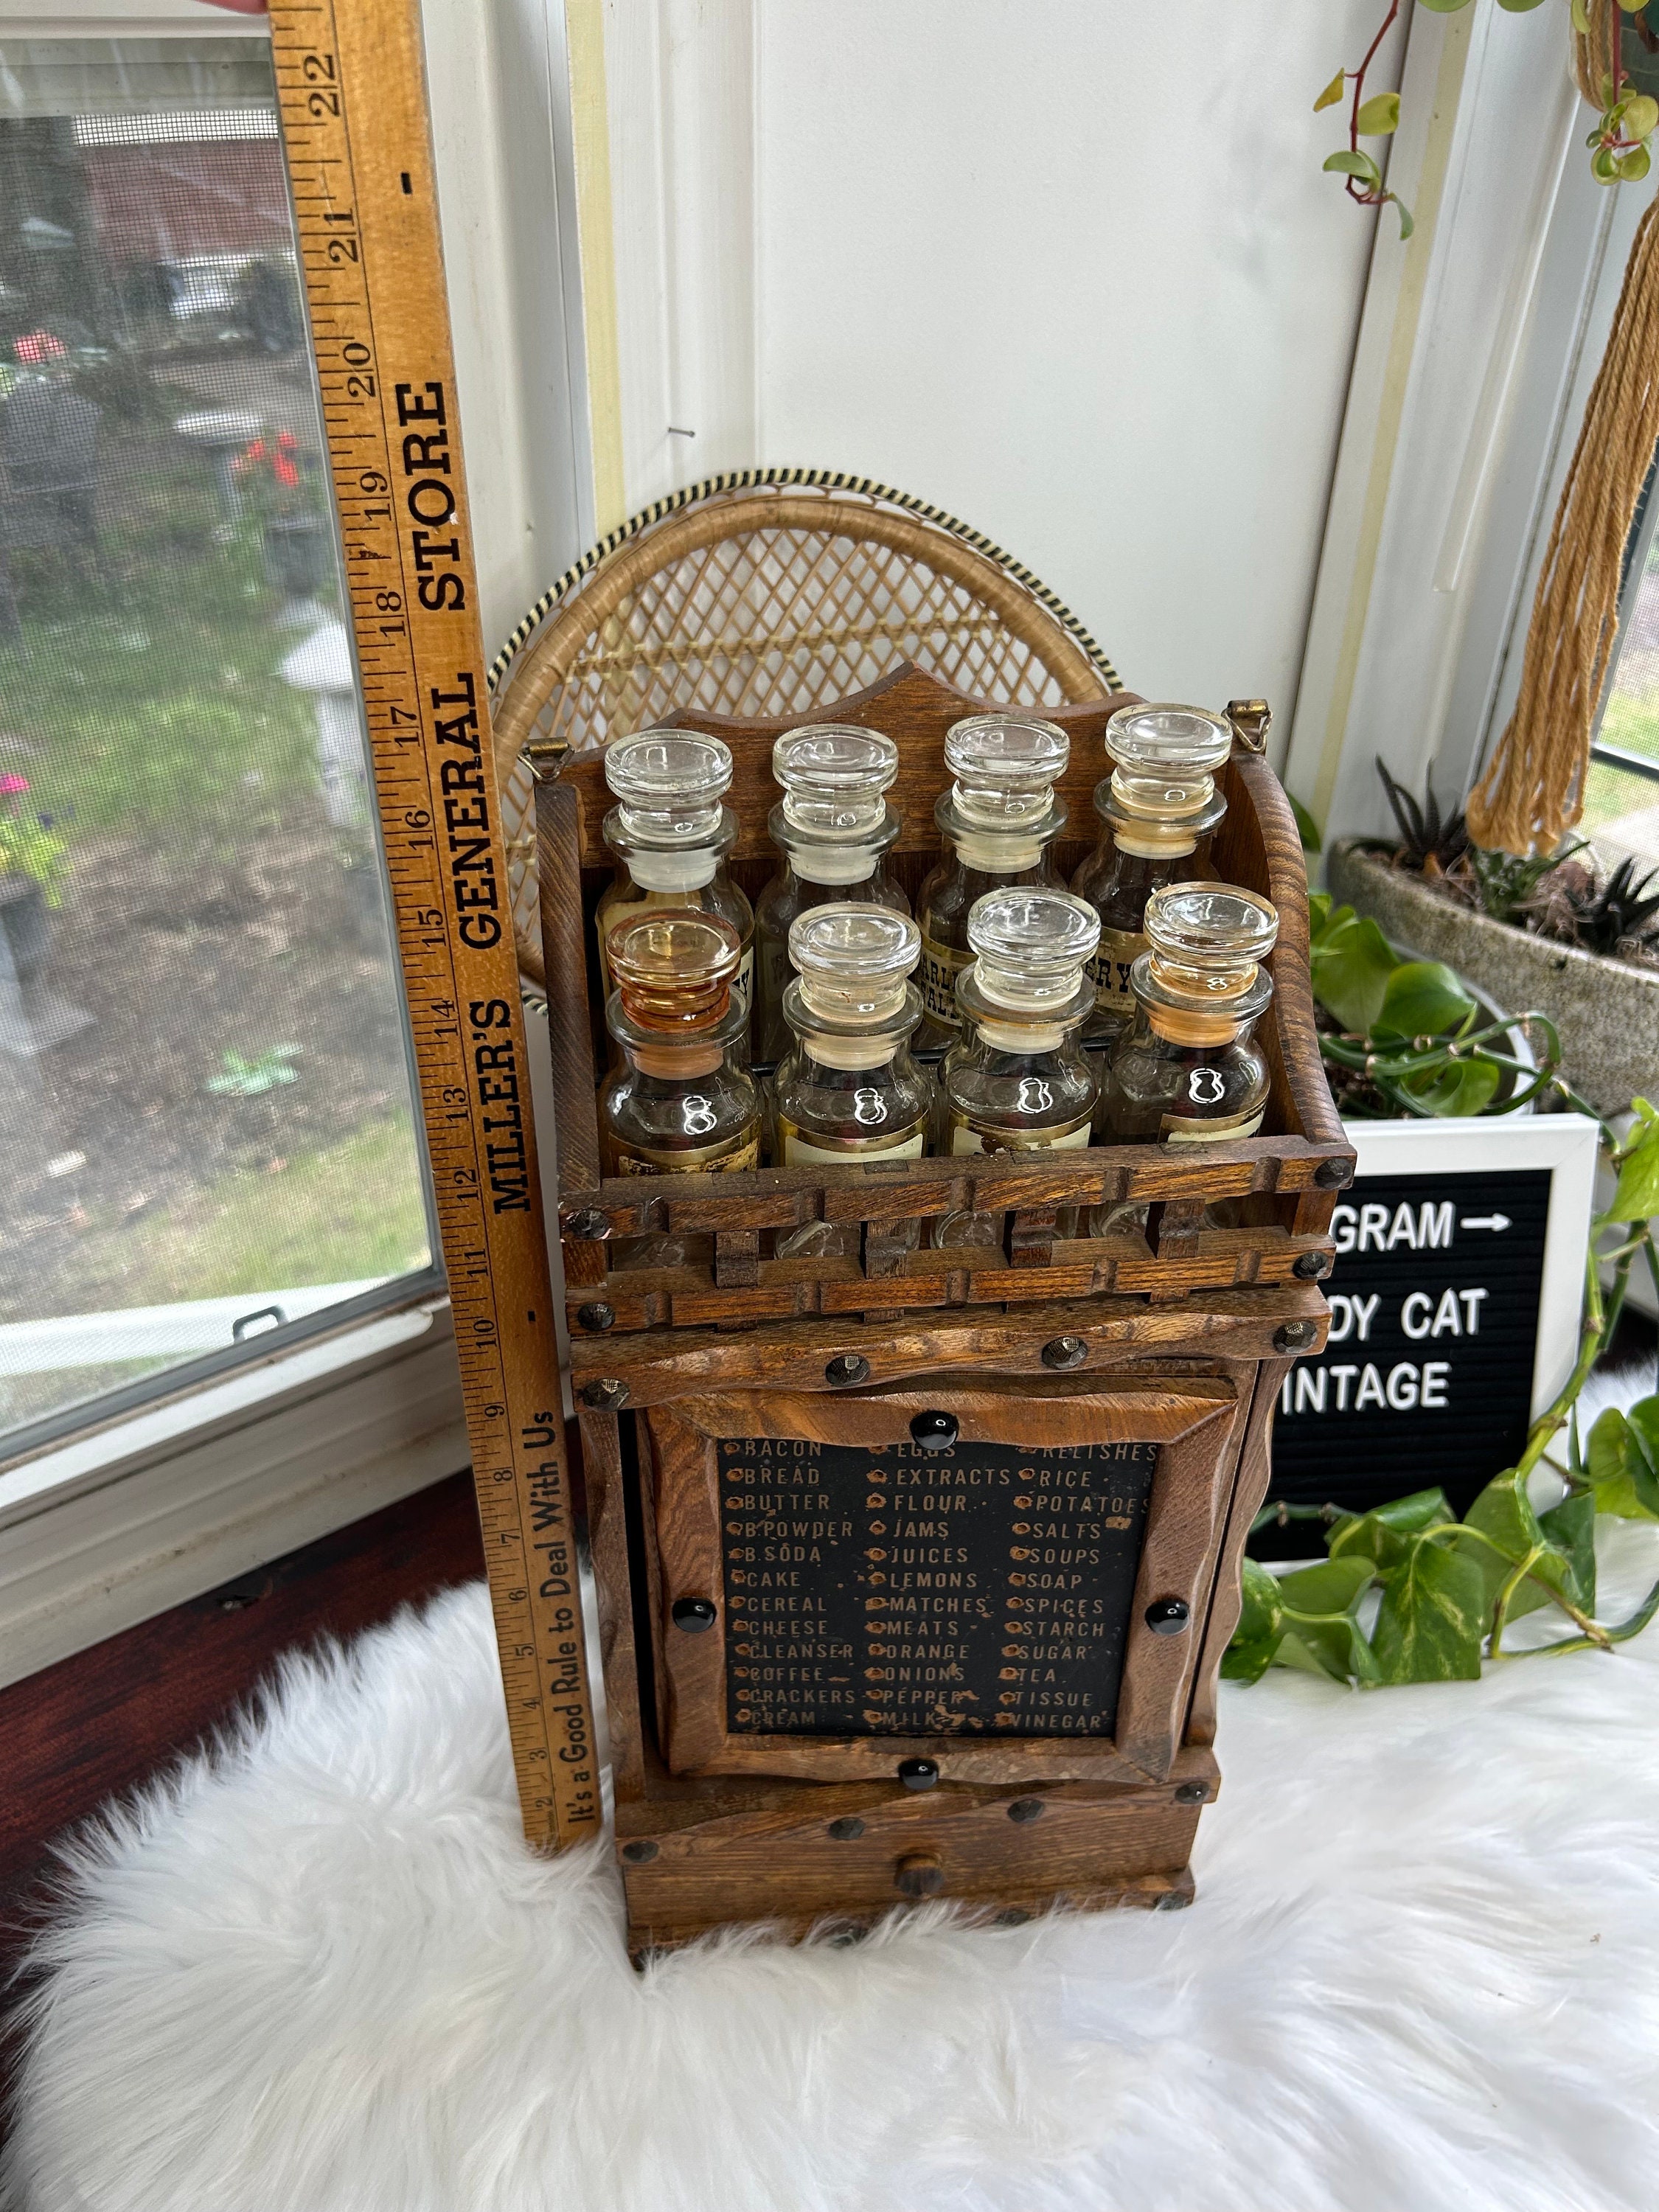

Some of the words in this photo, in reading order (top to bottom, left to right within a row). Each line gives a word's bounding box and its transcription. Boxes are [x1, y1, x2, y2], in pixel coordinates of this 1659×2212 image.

[303, 55, 340, 116] 22
[324, 208, 359, 263] 21
[343, 343, 375, 398] 20
[360, 471, 392, 521] 19
[395, 382, 465, 611] STORE
[376, 591, 406, 637] 18
[391, 706, 420, 747] 17
[431, 672, 501, 949] GENERAL
[405, 810, 435, 850] 16
[419, 909, 446, 947] 15
[431, 1000, 458, 1037] 14
[443, 1087, 470, 1121] 13
[470, 998, 532, 1214] MILLER'S
[454, 1169, 479, 1201] 12
[1329, 1200, 1456, 1253] GRAM
[465, 1248, 487, 1276] 11
[1327, 1293, 1381, 1342] DY
[1402, 1287, 1489, 1339] CAT
[473, 1319, 497, 1348] 10
[1281, 1362, 1451, 1415] INTAGE
[484, 1405, 504, 1417] 9
[522, 1411, 556, 1450] Us
[745, 1440, 821, 1457] BACON
[1043, 1445, 1157, 1461] RELISHES
[494, 1470, 513, 1482] 8
[745, 1468, 820, 1484] BREAD
[897, 1469, 1010, 1485] EXTRACTS
[1039, 1470, 1091, 1486] RICE
[526, 1461, 563, 1532] With
[745, 1495, 830, 1510] BUTTER
[894, 1495, 967, 1511] FLOUR
[894, 1521, 949, 1537] JAMS
[1033, 1523, 1101, 1539] SALTS
[501, 1533, 521, 1545] 7
[891, 1547, 968, 1563] JUICES
[1030, 1548, 1100, 1565] SOUPS
[534, 1541, 571, 1597] Deal
[748, 1572, 800, 1587] CAKE
[891, 1573, 978, 1588] LEMONS
[1027, 1573, 1082, 1589] SOAP
[509, 1590, 526, 1601] 6
[748, 1597, 827, 1612] CEREAL
[889, 1596, 986, 1613] MATCHES
[1025, 1598, 1104, 1614] SPICES
[549, 1607, 574, 1633] to
[749, 1621, 827, 1635] CHEESE
[887, 1621, 959, 1635] MEATS
[1023, 1621, 1105, 1637] STARCH
[515, 1646, 534, 1656] 5
[750, 1644, 853, 1658] CLEANSER
[886, 1644, 970, 1659] ORANGE
[1020, 1645, 1086, 1660] SUGAR
[548, 1641, 580, 1694] Rule
[751, 1667, 824, 1681] COFFEE
[886, 1666, 964, 1681] ONIONS
[1018, 1668, 1056, 1682] TEA
[523, 1699, 540, 1710] 4
[750, 1690, 855, 1703] CRACKERS
[883, 1690, 960, 1704] PEPPER
[1015, 1691, 1092, 1706] TISSUE
[751, 1711, 815, 1725] CREAM
[883, 1711, 936, 1726] MILK
[1012, 1714, 1101, 1728] VINEGAR
[554, 1703, 587, 1762] Good
[529, 1749, 547, 1760] 3
[574, 1770, 590, 1782] a
[536, 1797, 552, 1808] 2
[568, 1791, 595, 1823] It's
